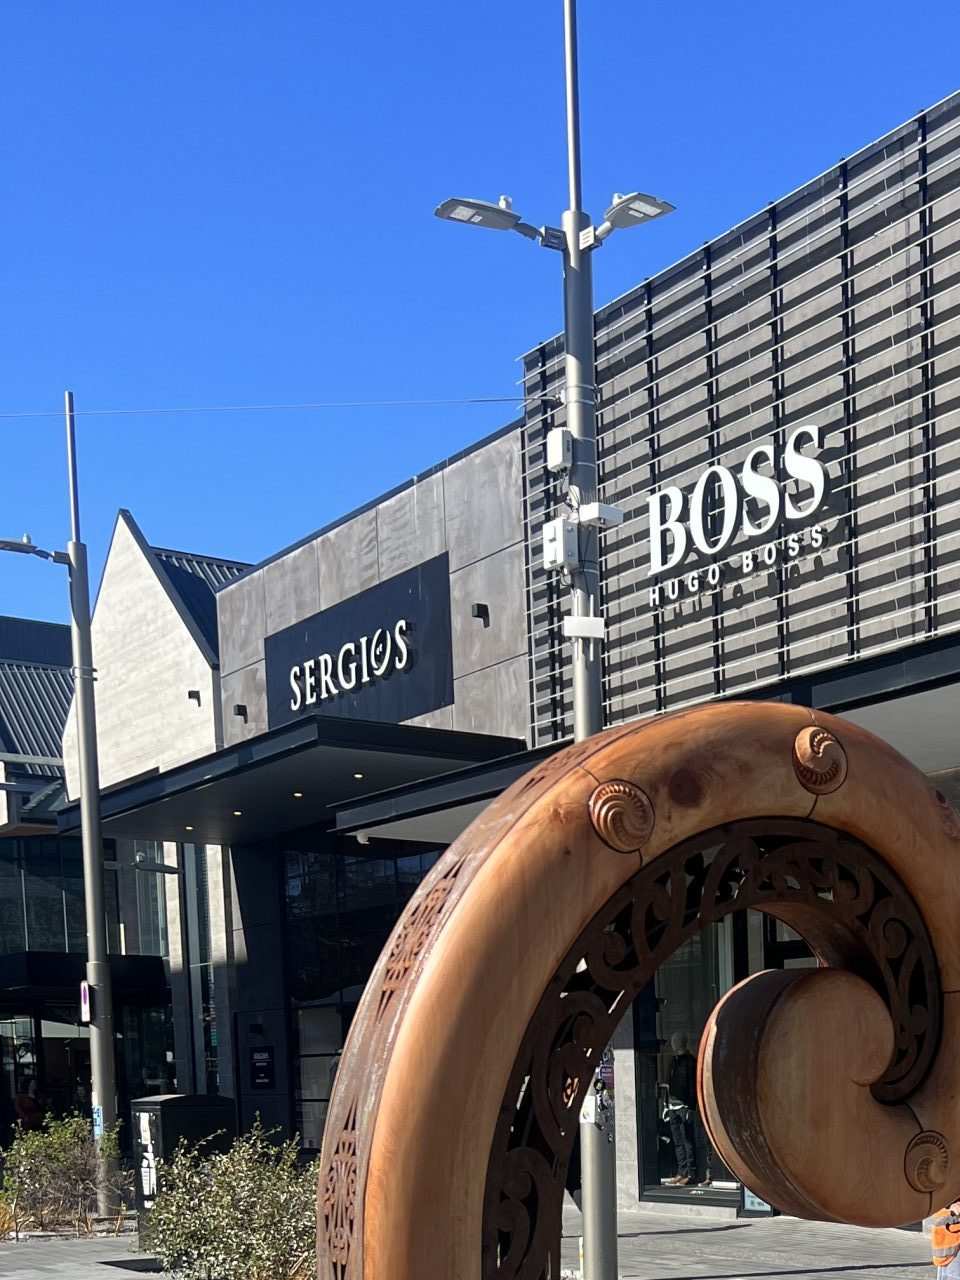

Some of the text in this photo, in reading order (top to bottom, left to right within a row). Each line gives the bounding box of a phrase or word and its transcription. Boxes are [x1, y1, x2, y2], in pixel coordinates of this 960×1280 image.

[646, 424, 829, 576] BOSS
[649, 524, 823, 608] HUGO BOSS
[289, 619, 408, 712] SERGIOS
